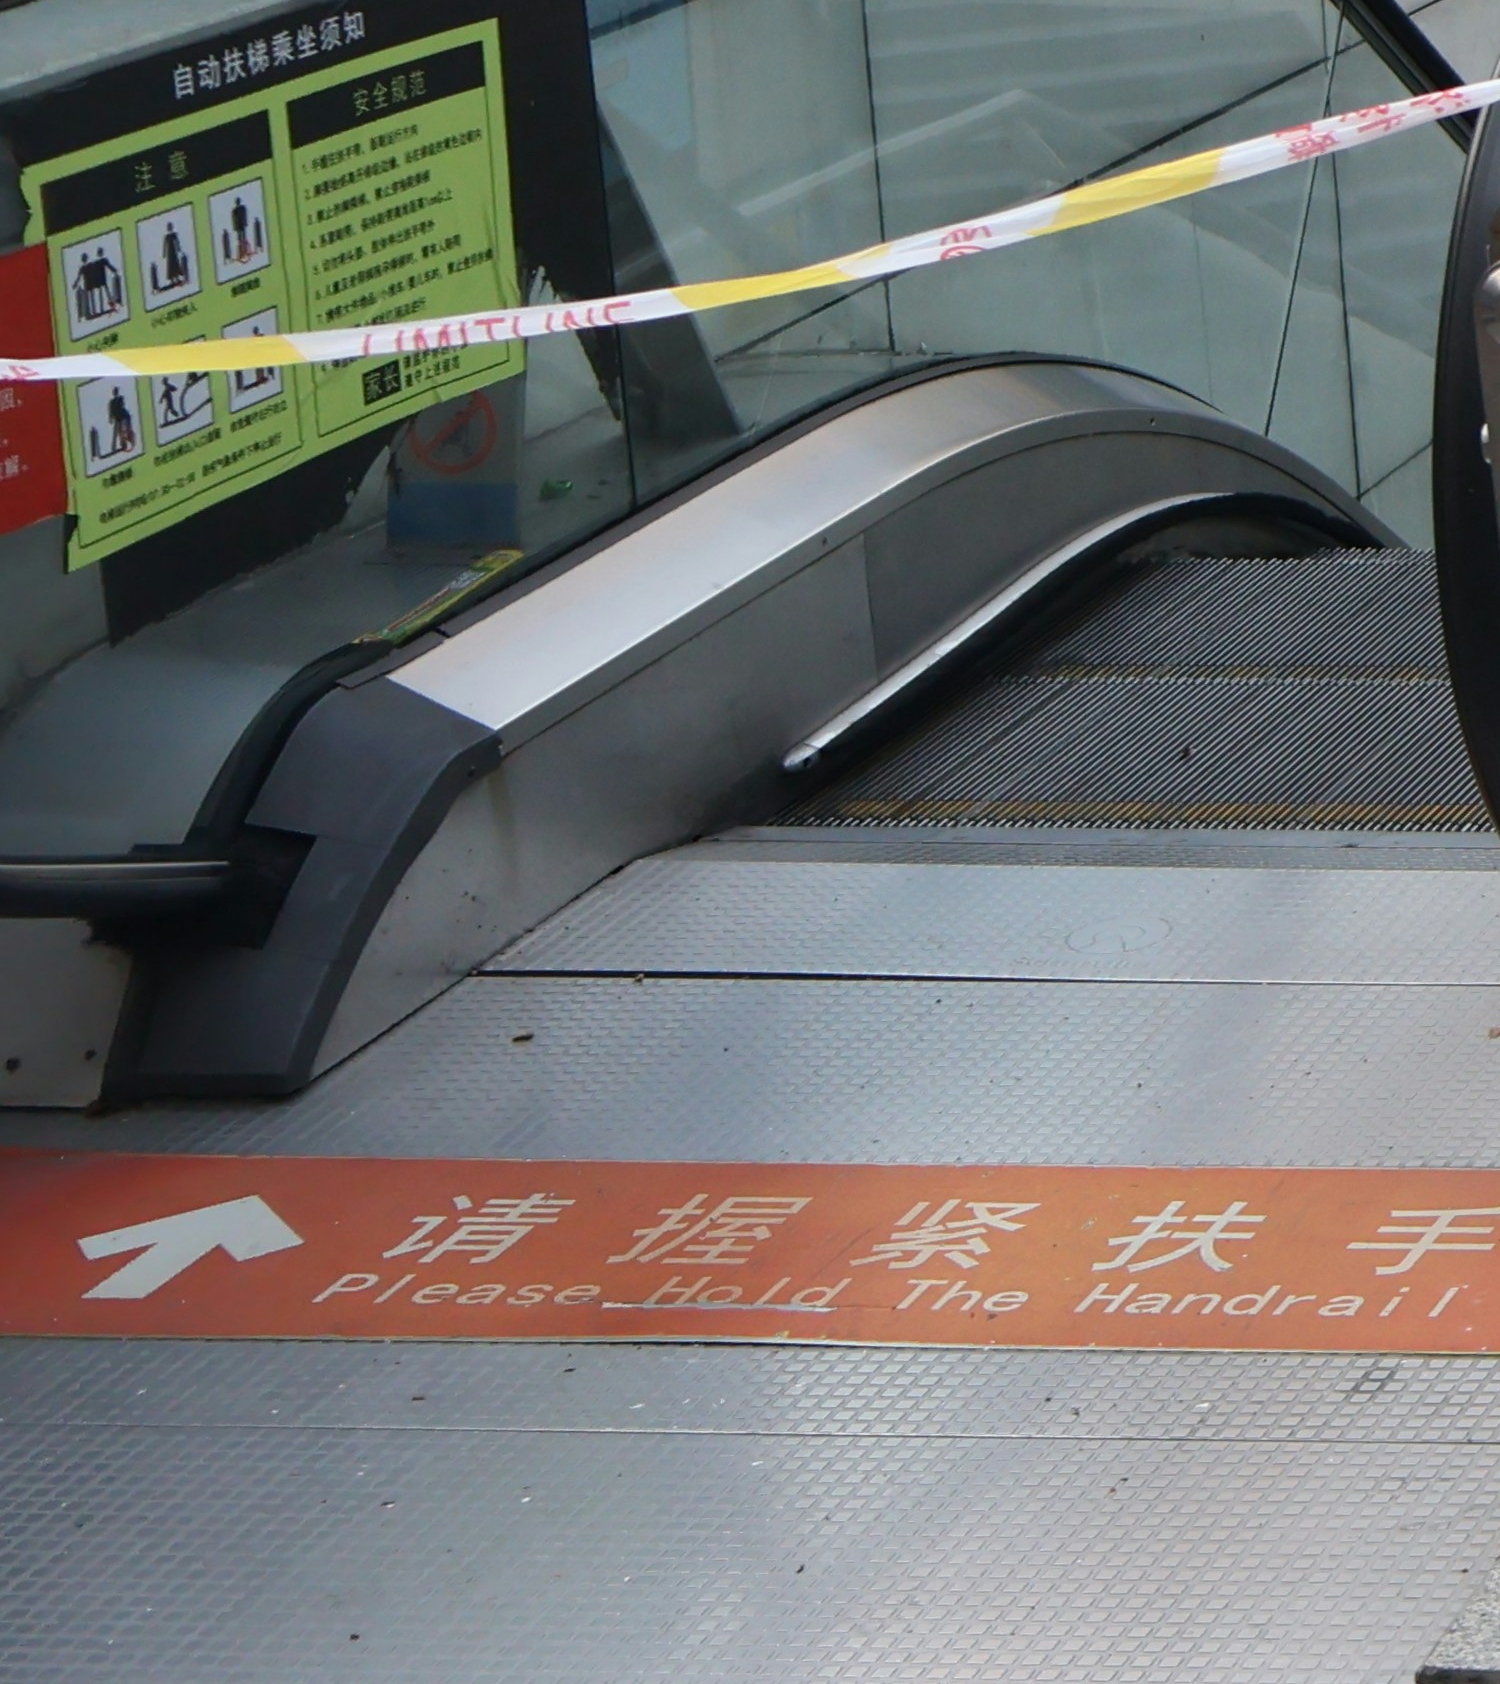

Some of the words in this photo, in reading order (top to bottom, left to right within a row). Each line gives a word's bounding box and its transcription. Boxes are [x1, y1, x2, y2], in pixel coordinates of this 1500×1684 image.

[172, 11, 366, 100] 自动扶梯乘坐须知
[352, 70, 427, 116] 安全规范
[134, 150, 190, 193] 注意
[365, 367, 401, 404] 家长
[312, 1272, 602, 1307] Please
[643, 1275, 852, 1310] Hold
[896, 1278, 1030, 1312] The
[1073, 1282, 1466, 1318] Handrail
